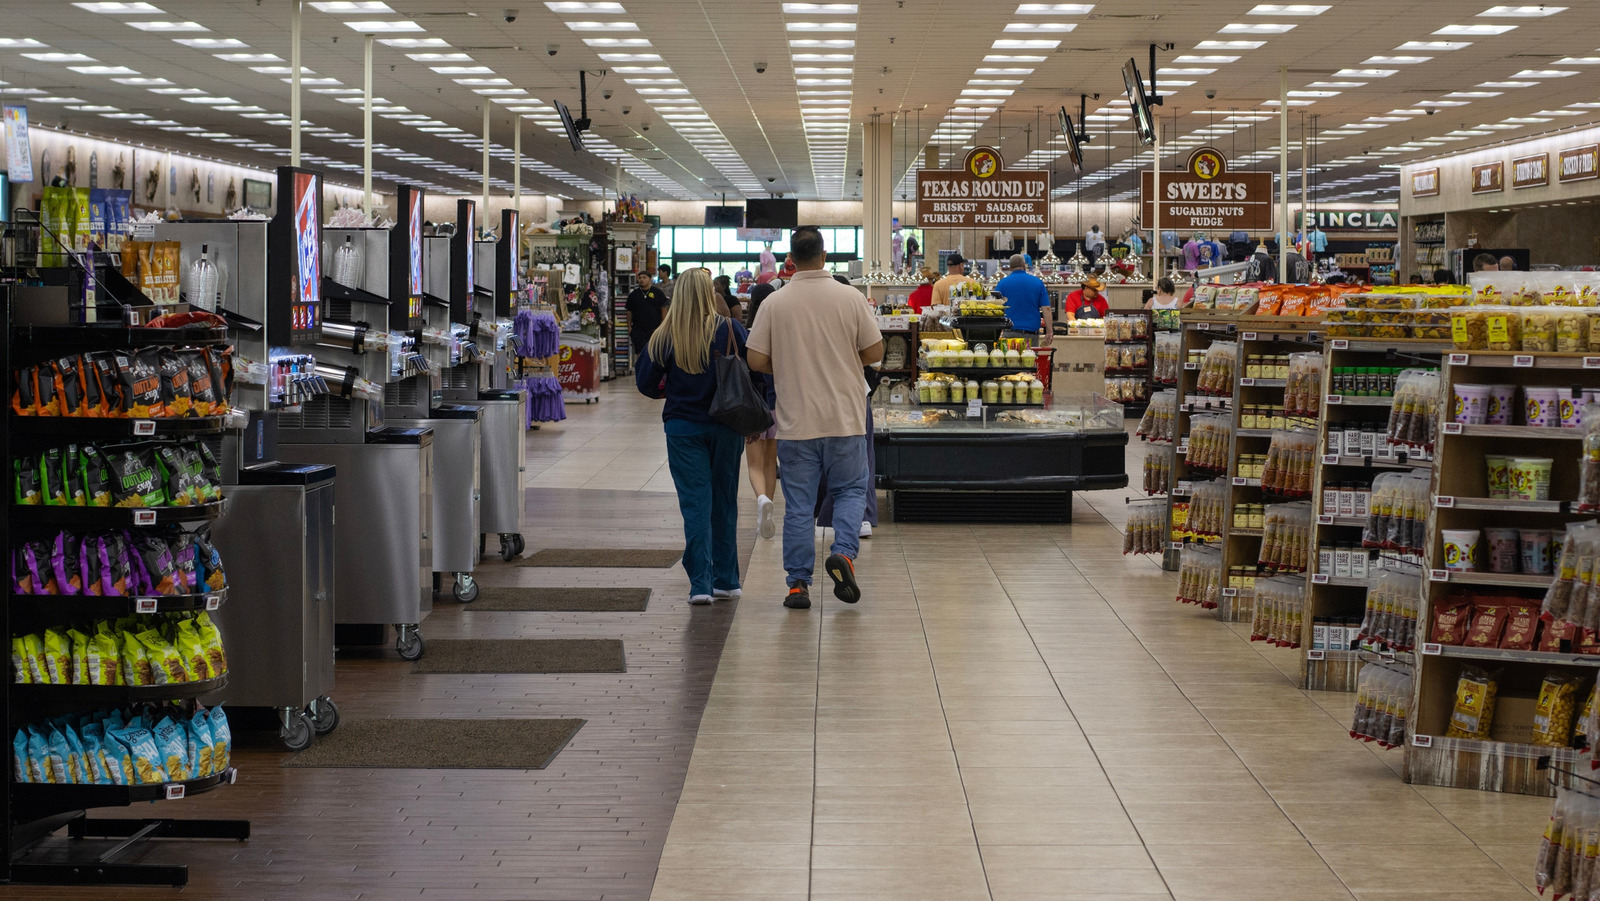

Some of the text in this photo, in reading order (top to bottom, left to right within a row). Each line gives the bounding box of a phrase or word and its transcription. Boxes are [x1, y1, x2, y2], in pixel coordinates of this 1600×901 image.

[922, 181, 1045, 197] TEXAS ROUND UP
[1167, 182, 1247, 200] SWEETS
[933, 203, 1034, 212] BRISKET SAUSAGE
[1169, 207, 1244, 216] SUGARED NUTS
[922, 214, 1044, 224] TURKEY PULLED PORK
[1190, 217, 1224, 226] FUDGE
[122, 469, 152, 489] OUTLAW
